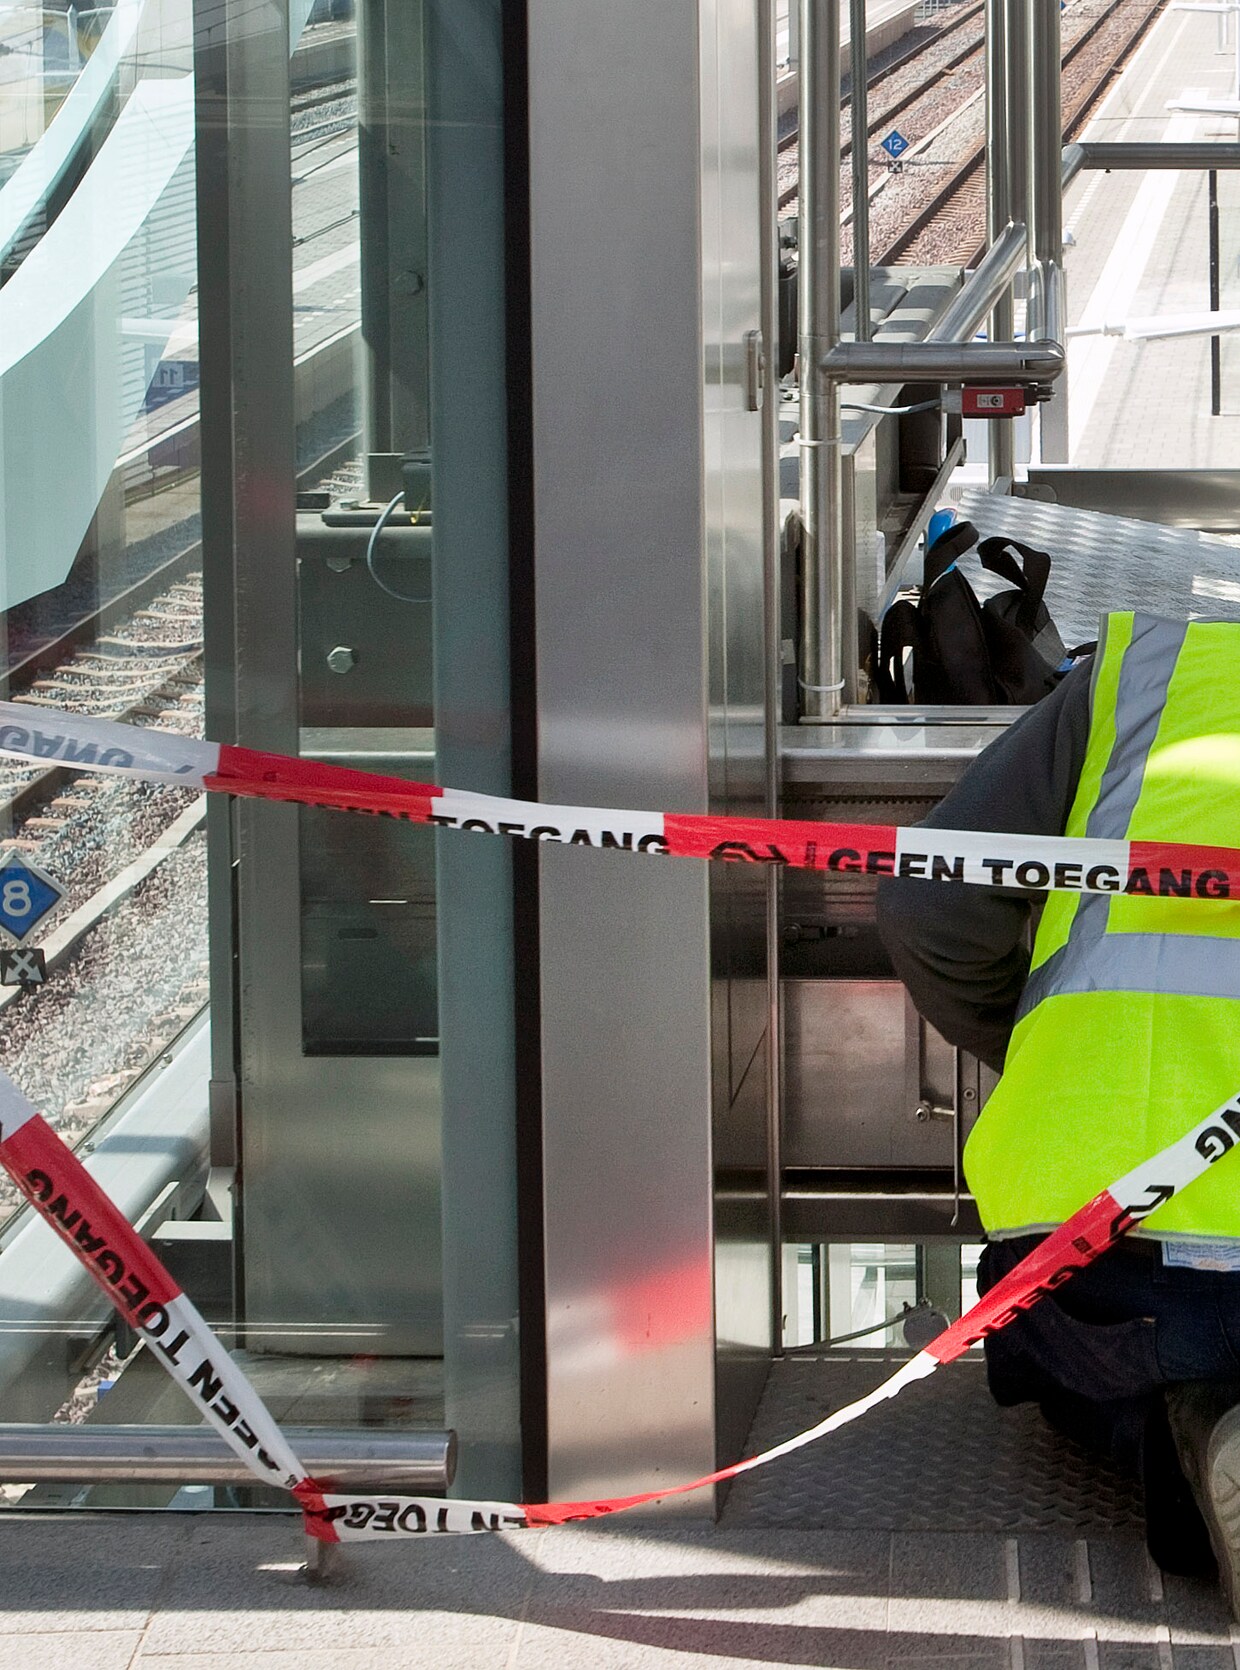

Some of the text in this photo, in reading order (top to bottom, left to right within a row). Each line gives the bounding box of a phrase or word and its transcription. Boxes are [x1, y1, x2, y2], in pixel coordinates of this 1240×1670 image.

[888, 139, 903, 150] 12
[828, 848, 965, 882] GEEN
[982, 858, 1231, 898] TOEGANG
[3, 880, 31, 917] 8
[23, 1168, 190, 1368] TOEGANG
